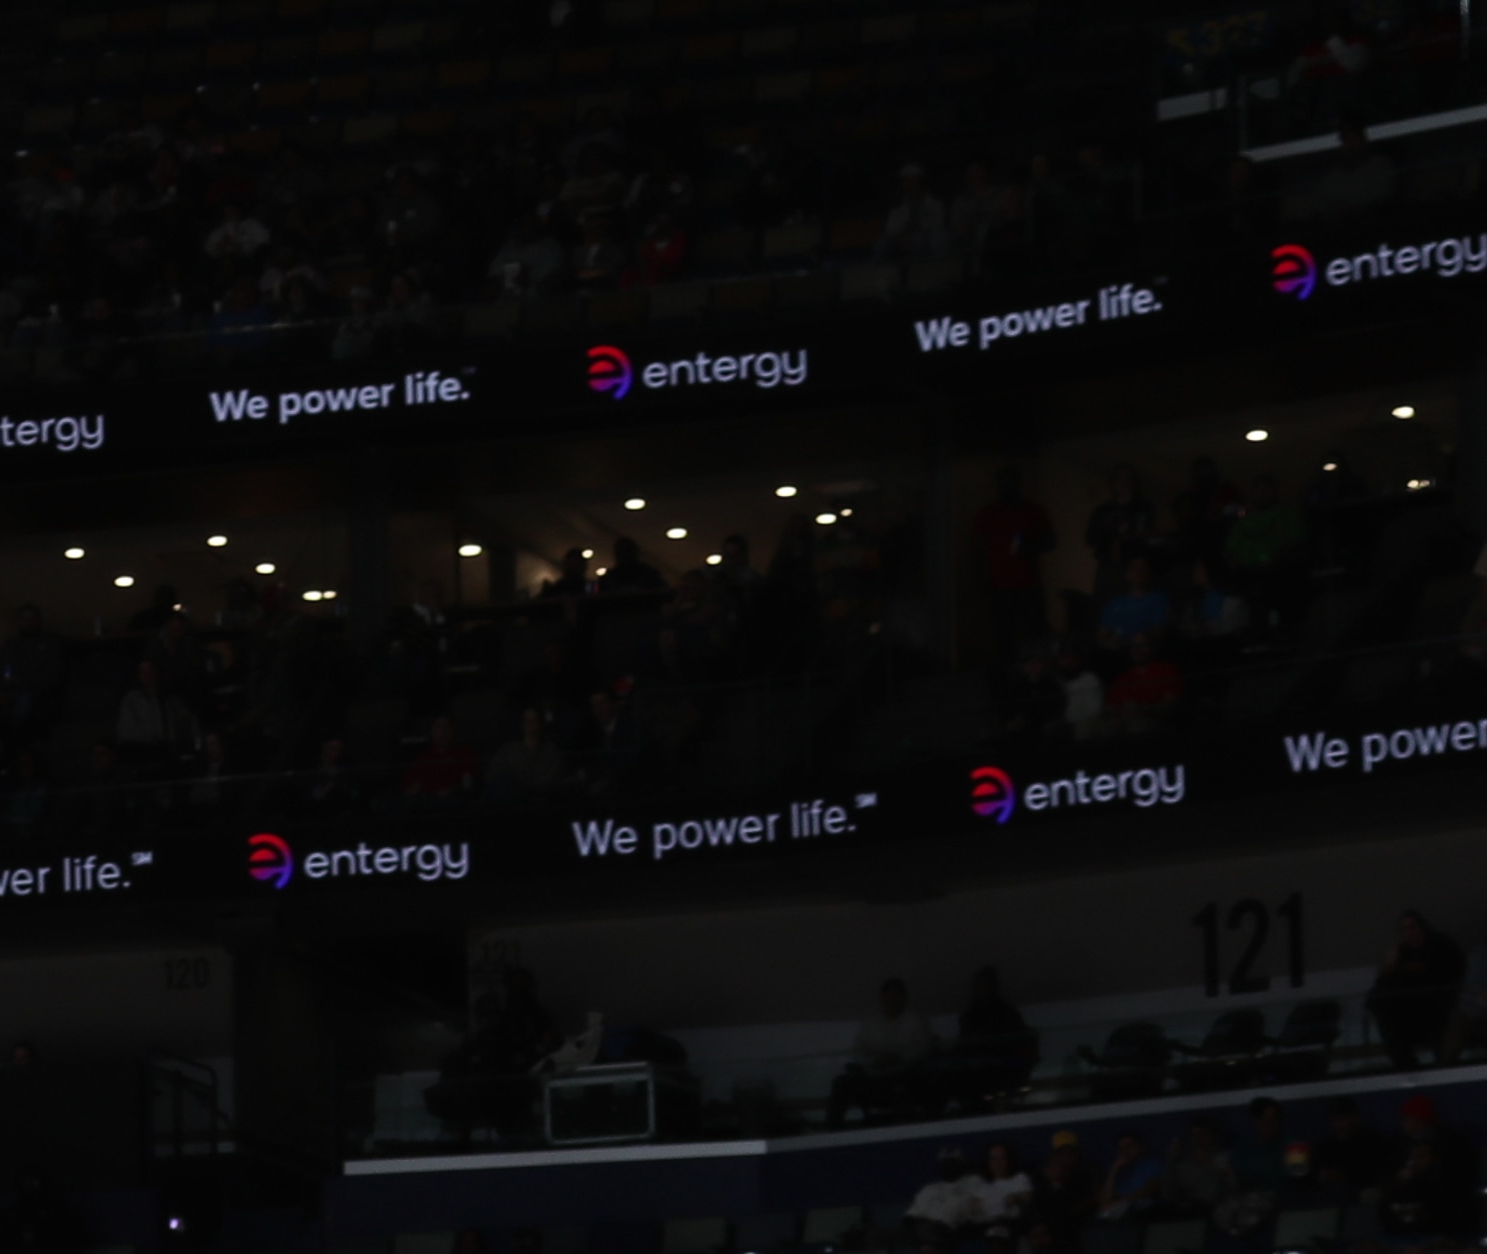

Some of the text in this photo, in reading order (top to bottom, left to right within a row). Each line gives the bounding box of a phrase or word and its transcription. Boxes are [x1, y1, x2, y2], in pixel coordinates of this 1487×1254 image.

[1325, 235, 1487, 287] entergy
[914, 316, 972, 352] We
[979, 299, 1091, 350] power
[642, 351, 808, 390] entergy
[209, 389, 269, 423] We
[279, 382, 396, 425] power
[1285, 733, 1349, 774] We
[1024, 766, 1185, 813] entergy
[572, 820, 639, 858] We
[652, 811, 779, 853] power
[302, 842, 471, 882] entergy
[1191, 890, 1305, 999] 121
[163, 956, 211, 991] 120
